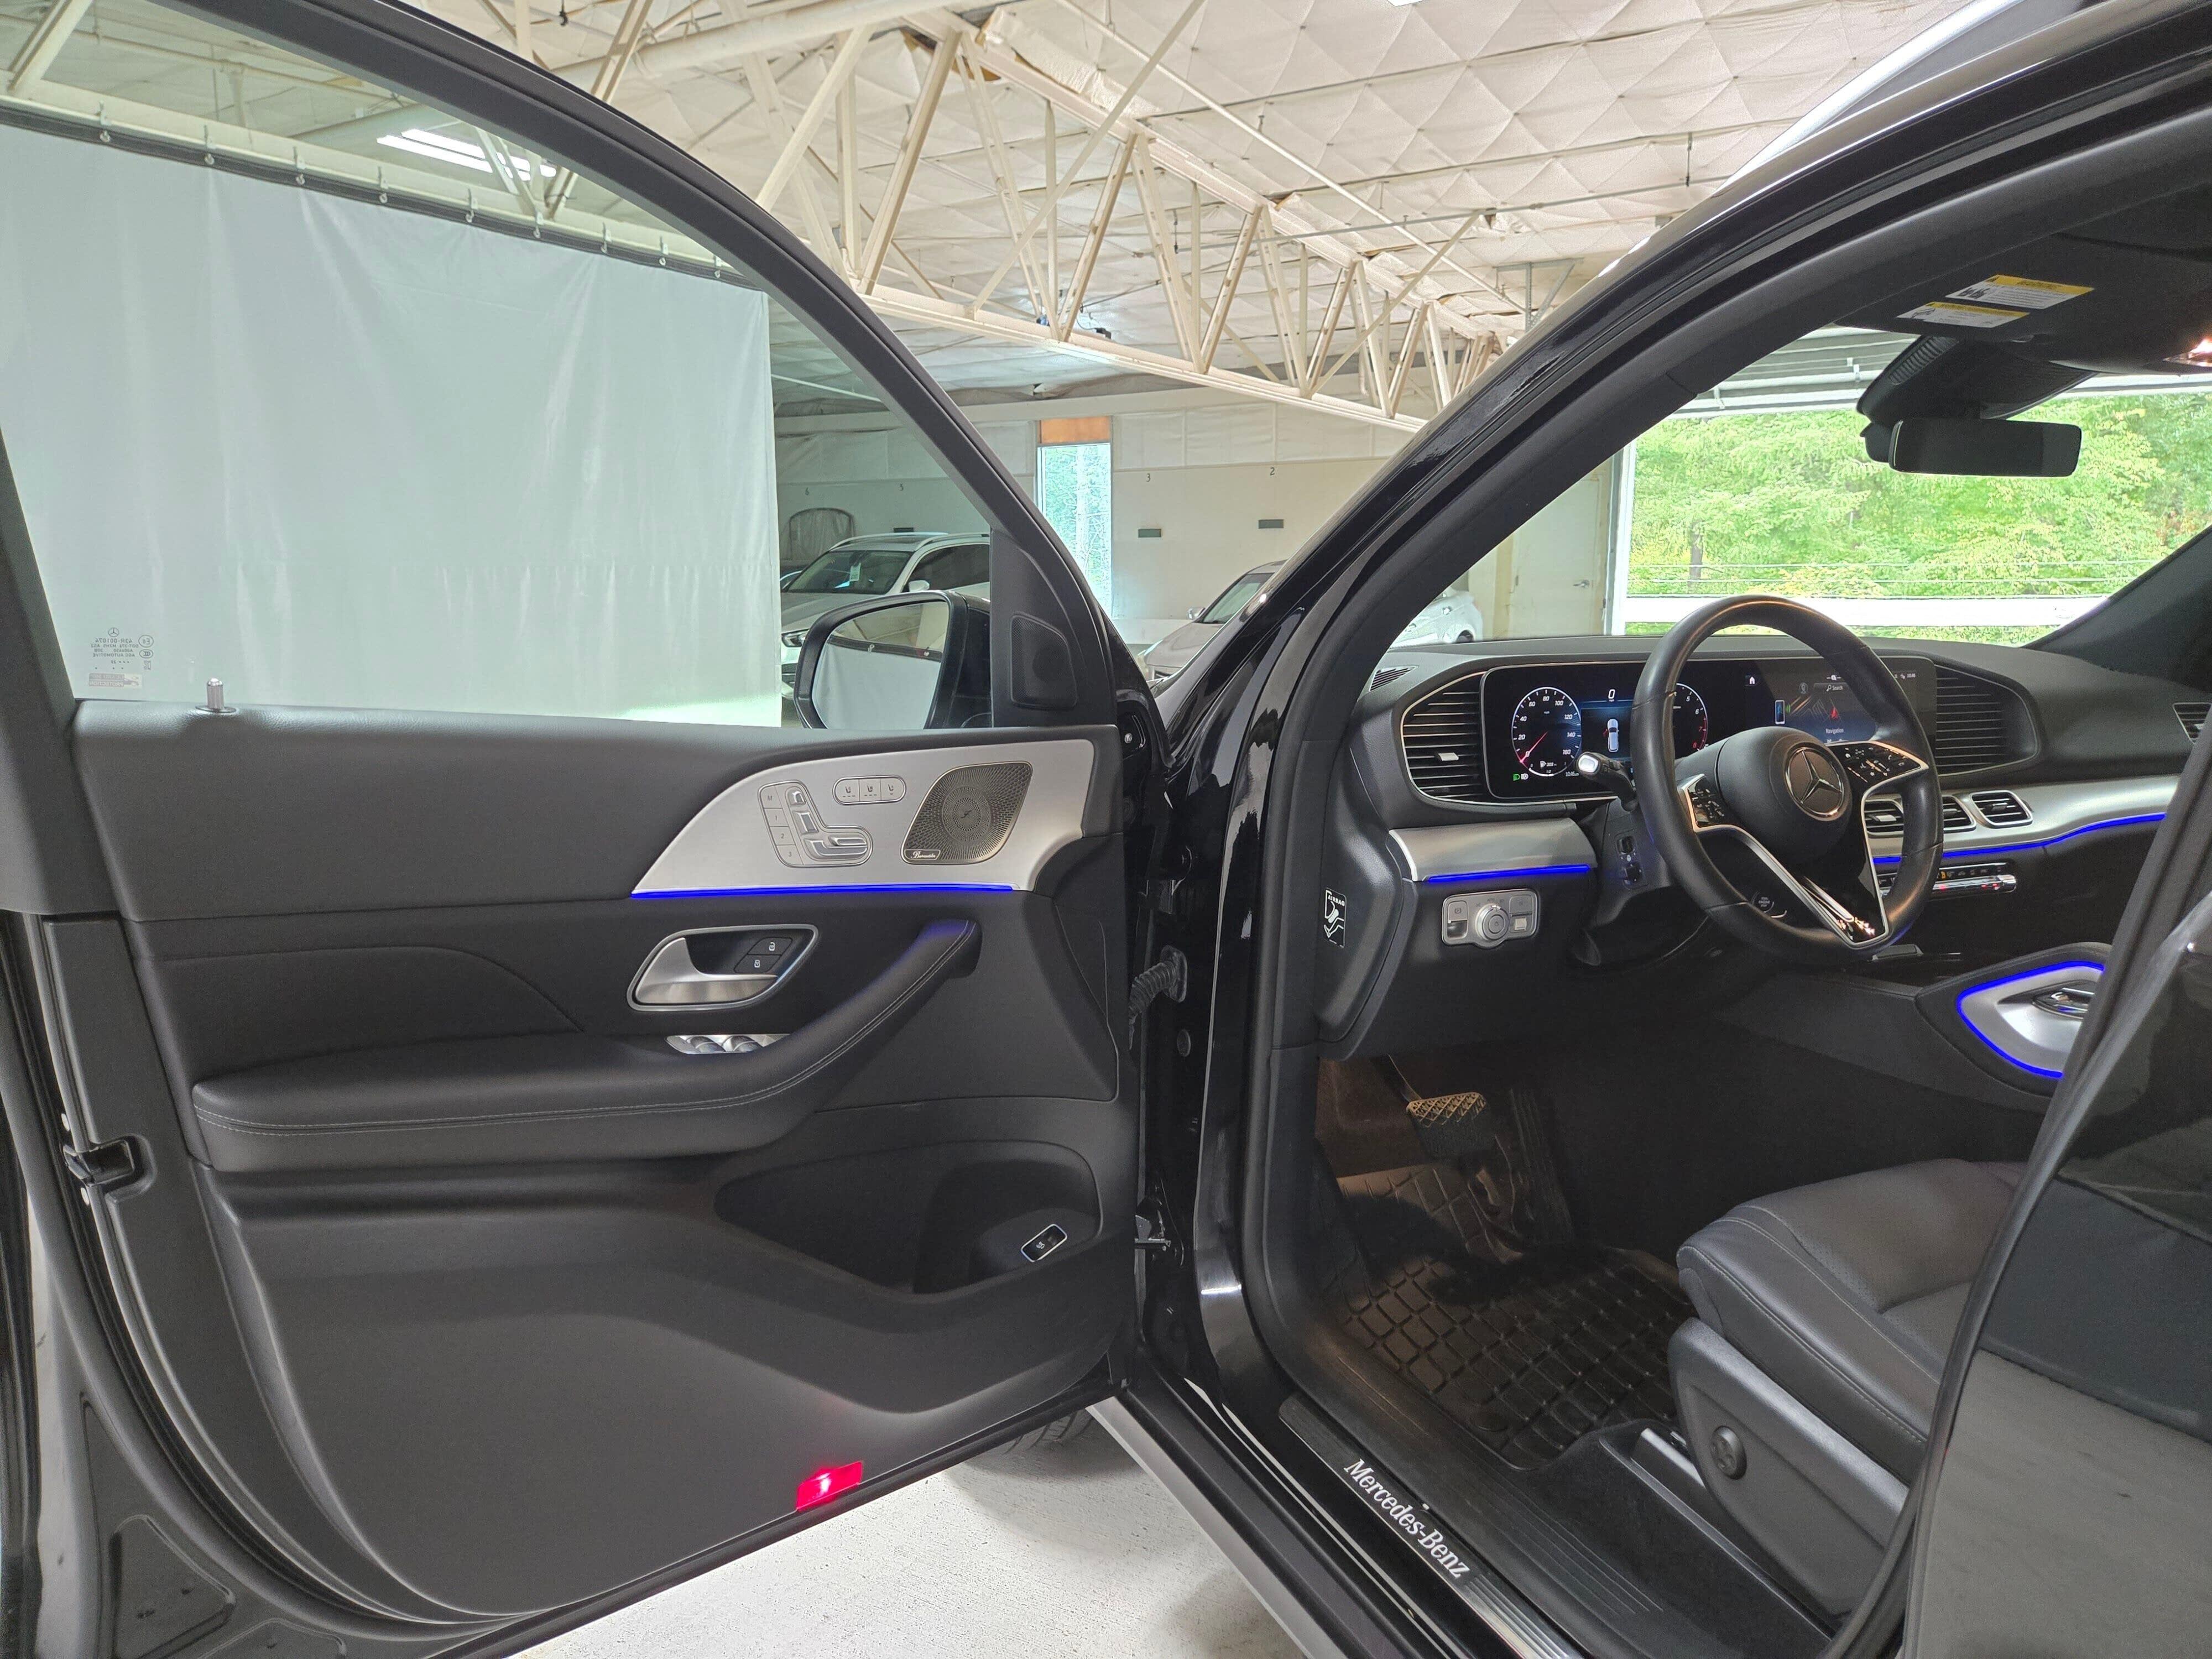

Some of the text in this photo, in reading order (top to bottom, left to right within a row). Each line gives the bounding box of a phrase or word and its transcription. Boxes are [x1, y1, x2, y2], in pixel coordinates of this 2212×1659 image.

[1270, 467, 1275, 476] 2
[1146, 473, 1151, 482] 3
[805, 487, 810, 495] 6
[1608, 689, 1615, 699] 0
[1327, 895, 1345, 906] AIRBAG
[1344, 1459, 1470, 1578] Mercedes-Benz
